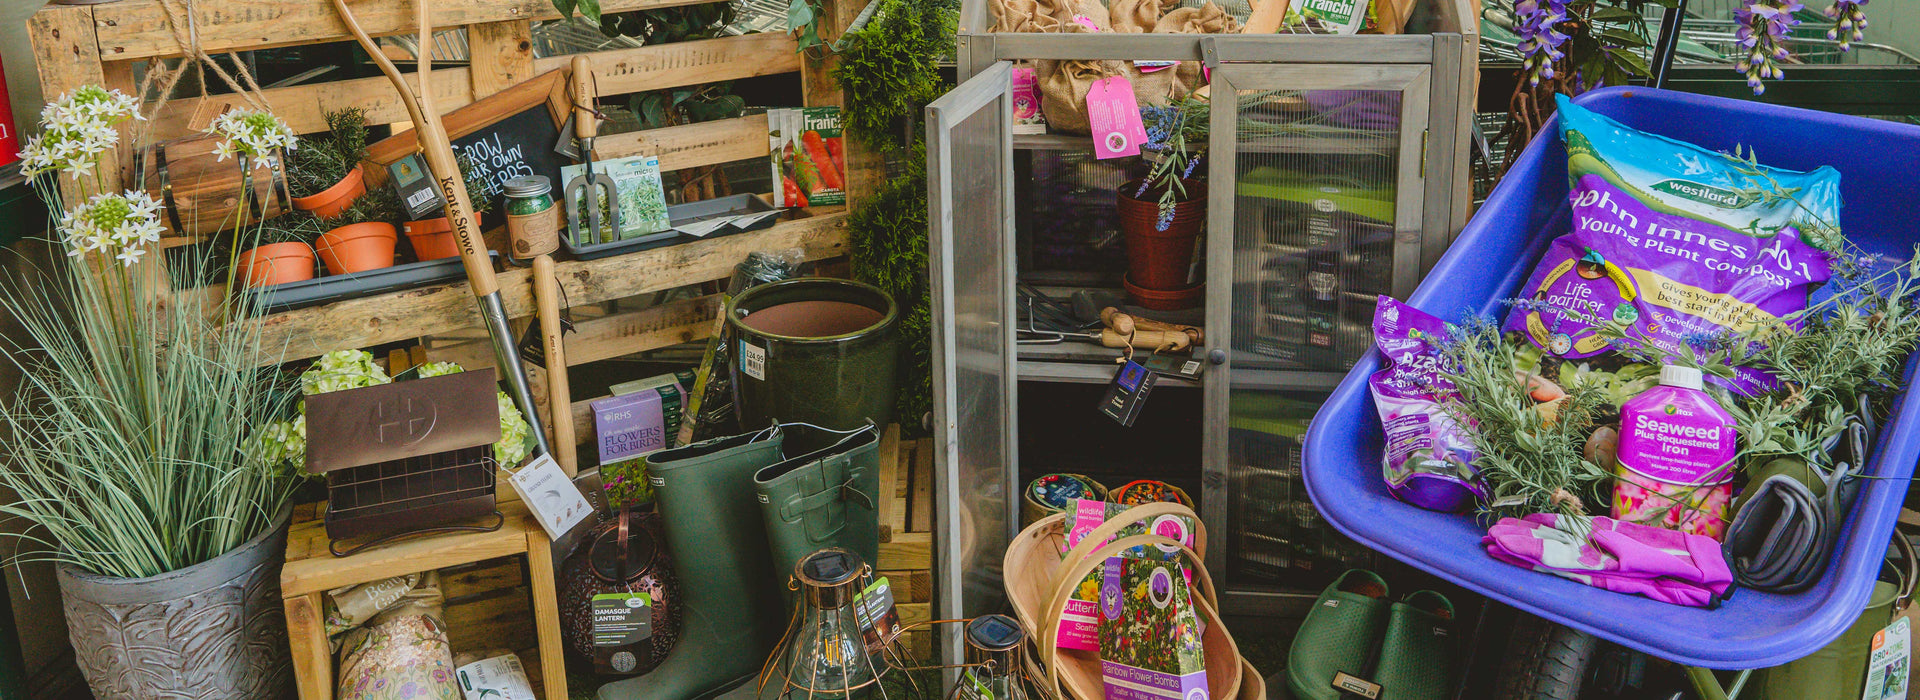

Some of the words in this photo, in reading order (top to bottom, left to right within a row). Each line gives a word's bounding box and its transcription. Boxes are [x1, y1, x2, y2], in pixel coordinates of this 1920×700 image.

[804, 114, 841, 131] Franc
[450, 132, 502, 166] ROW
[492, 144, 523, 168] OWN
[634, 168, 654, 176] micro
[441, 176, 459, 208] Kent
[1669, 181, 1739, 206] westland
[451, 209, 461, 218] &
[455, 217, 475, 256] Stowe
[1646, 222, 1749, 260] Innes
[1580, 216, 1640, 248] Young
[1644, 239, 1701, 263] Plant
[1704, 256, 1793, 290] Compost
[1564, 281, 1592, 298] Life
[1661, 281, 1693, 298] Gives
[1695, 292, 1730, 312] young
[1548, 294, 1606, 313] partner
[1657, 291, 1683, 307] best
[1685, 301, 1713, 316] start
[1714, 308, 1725, 319] in
[1660, 326, 1683, 339] Feed
[1655, 338, 1677, 352] Zinc
[1742, 371, 1761, 387] plant
[614, 410, 632, 421] RHS
[605, 426, 661, 447] FLOWERS
[1636, 415, 1720, 441] Seaweed
[606, 444, 629, 456] FOR
[629, 436, 661, 451] BIRDS
[1634, 429, 1655, 440] Plus
[1657, 433, 1720, 450] Sequestered
[1662, 443, 1689, 456] Iron
[1651, 463, 1669, 471] Makes
[1078, 507, 1103, 517] wildlife
[1075, 623, 1098, 633] Scatte
[1102, 662, 1129, 677] Rainbow
[1129, 668, 1153, 684] Flower
[1153, 674, 1180, 689] Bombs
